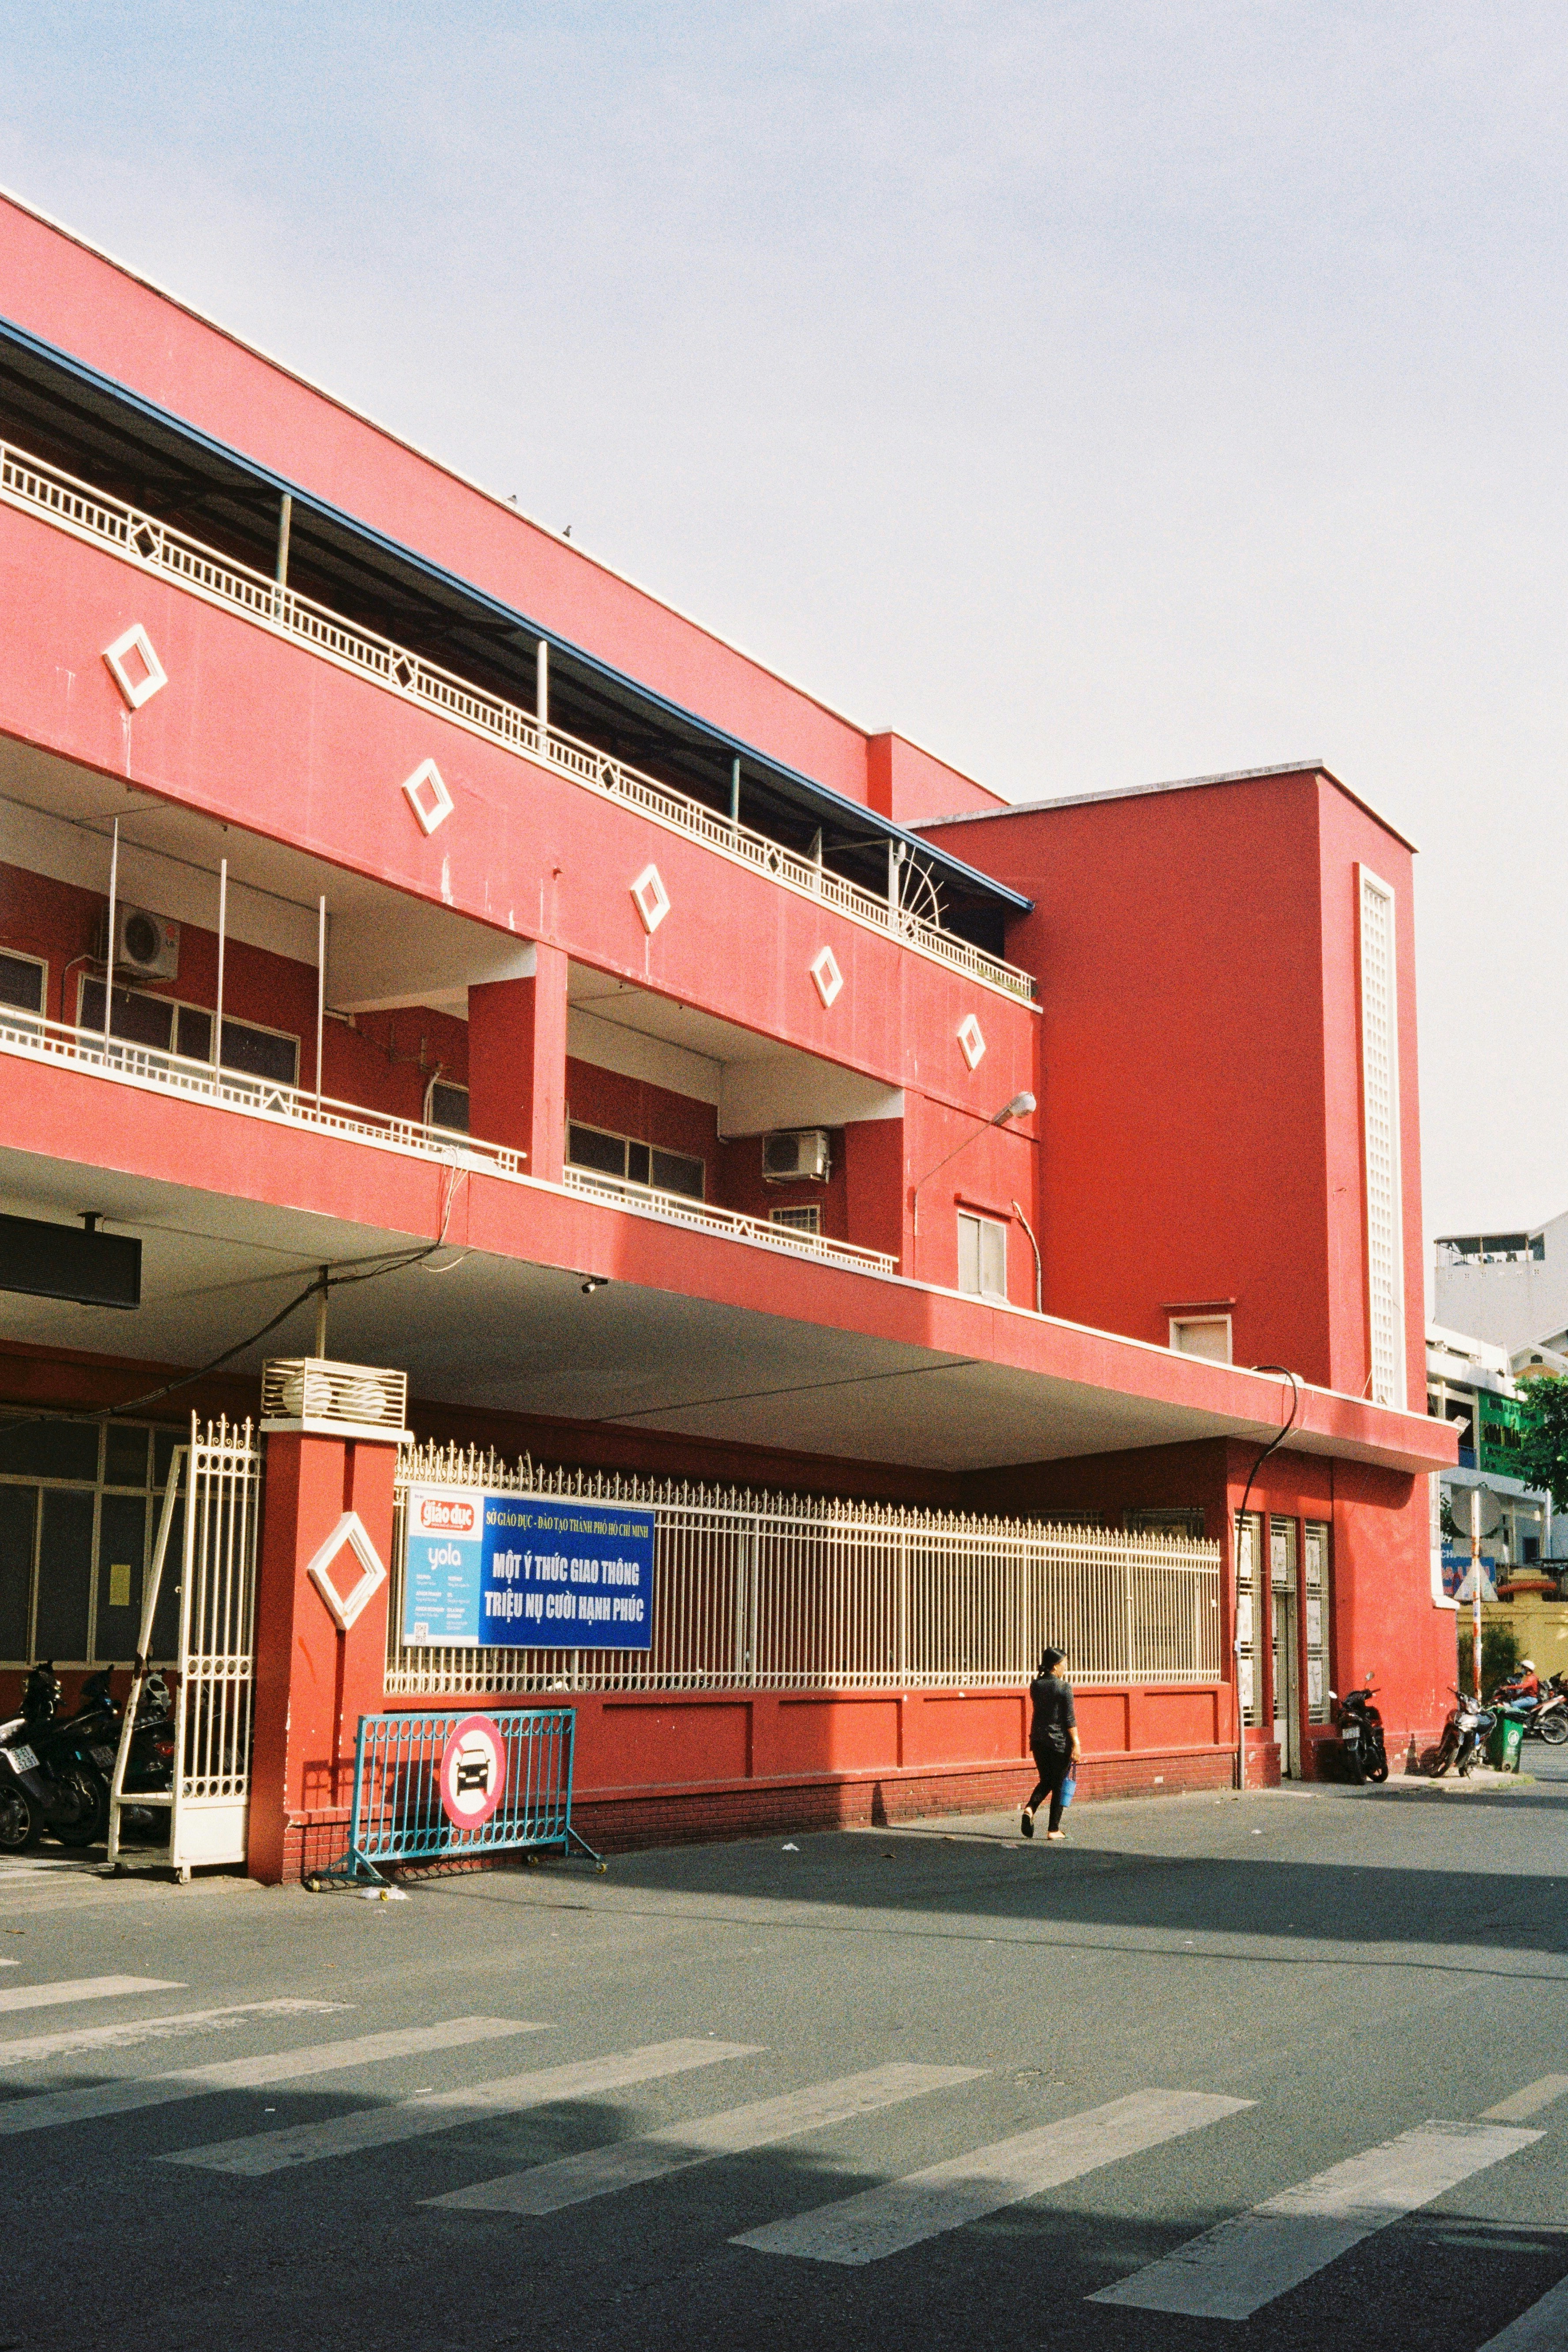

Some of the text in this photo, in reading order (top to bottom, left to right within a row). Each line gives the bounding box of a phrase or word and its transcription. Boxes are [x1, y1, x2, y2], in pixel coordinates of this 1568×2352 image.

[423, 1502, 450, 1526] giáo
[486, 1508, 496, 1525] SỞ
[497, 1509, 517, 1527] GIÁO
[518, 1514, 533, 1531] DỤC
[538, 1513, 553, 1529] ĐÀO
[554, 1517, 568, 1534] TẠO
[569, 1516, 592, 1533] THÀNH
[594, 1519, 607, 1535] PHỐ
[608, 1520, 618, 1536] HỒ
[619, 1521, 631, 1537] CHÍ
[632, 1525, 648, 1538] MINH
[428, 1543, 461, 1570] yola
[493, 1550, 639, 1586] MỘT Ý THỨC GIAO THÔNG
[485, 1588, 644, 1626] TRIỆU NỤ CƯỜI HẠNH PHÚC
